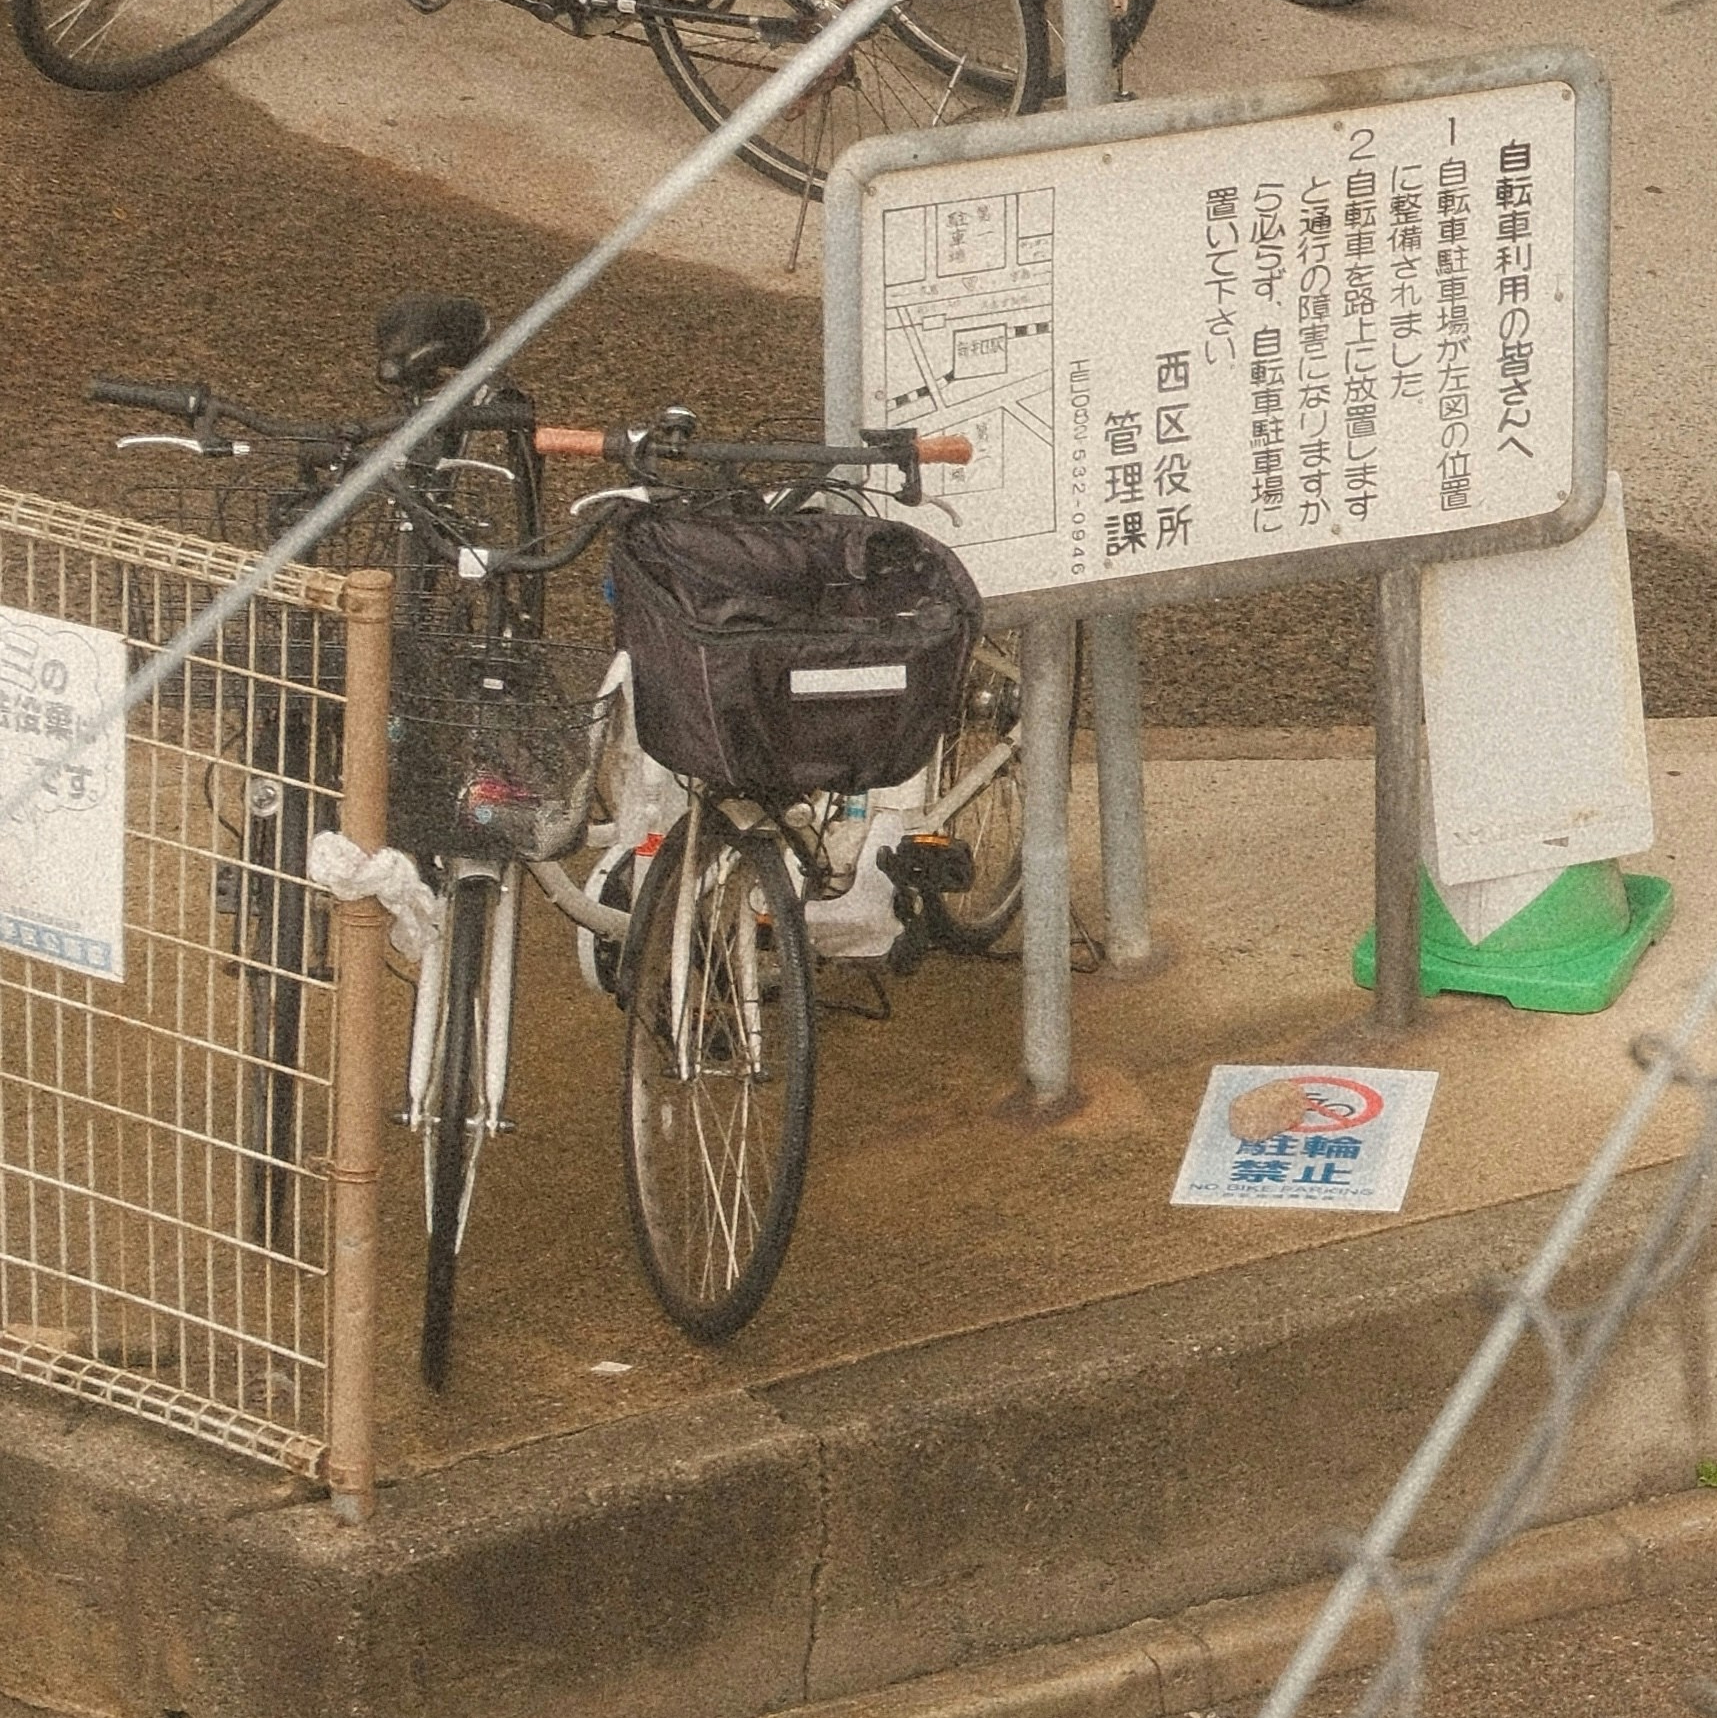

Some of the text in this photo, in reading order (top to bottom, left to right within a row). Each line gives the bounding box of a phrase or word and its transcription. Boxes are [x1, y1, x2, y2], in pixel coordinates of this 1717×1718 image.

[1297, 176, 1332, 527] と通行の障害になりますか
[1496, 139, 1534, 458] 自転車利用の皆さんへ
[1104, 409, 1147, 557] 管理課
[1153, 349, 1193, 551] 西区役所
[1189, 1183, 1375, 1196] NO BIKE PARKING
[1230, 1160, 1353, 1185] 禁止
[1236, 1135, 1362, 1159] 駐輪
